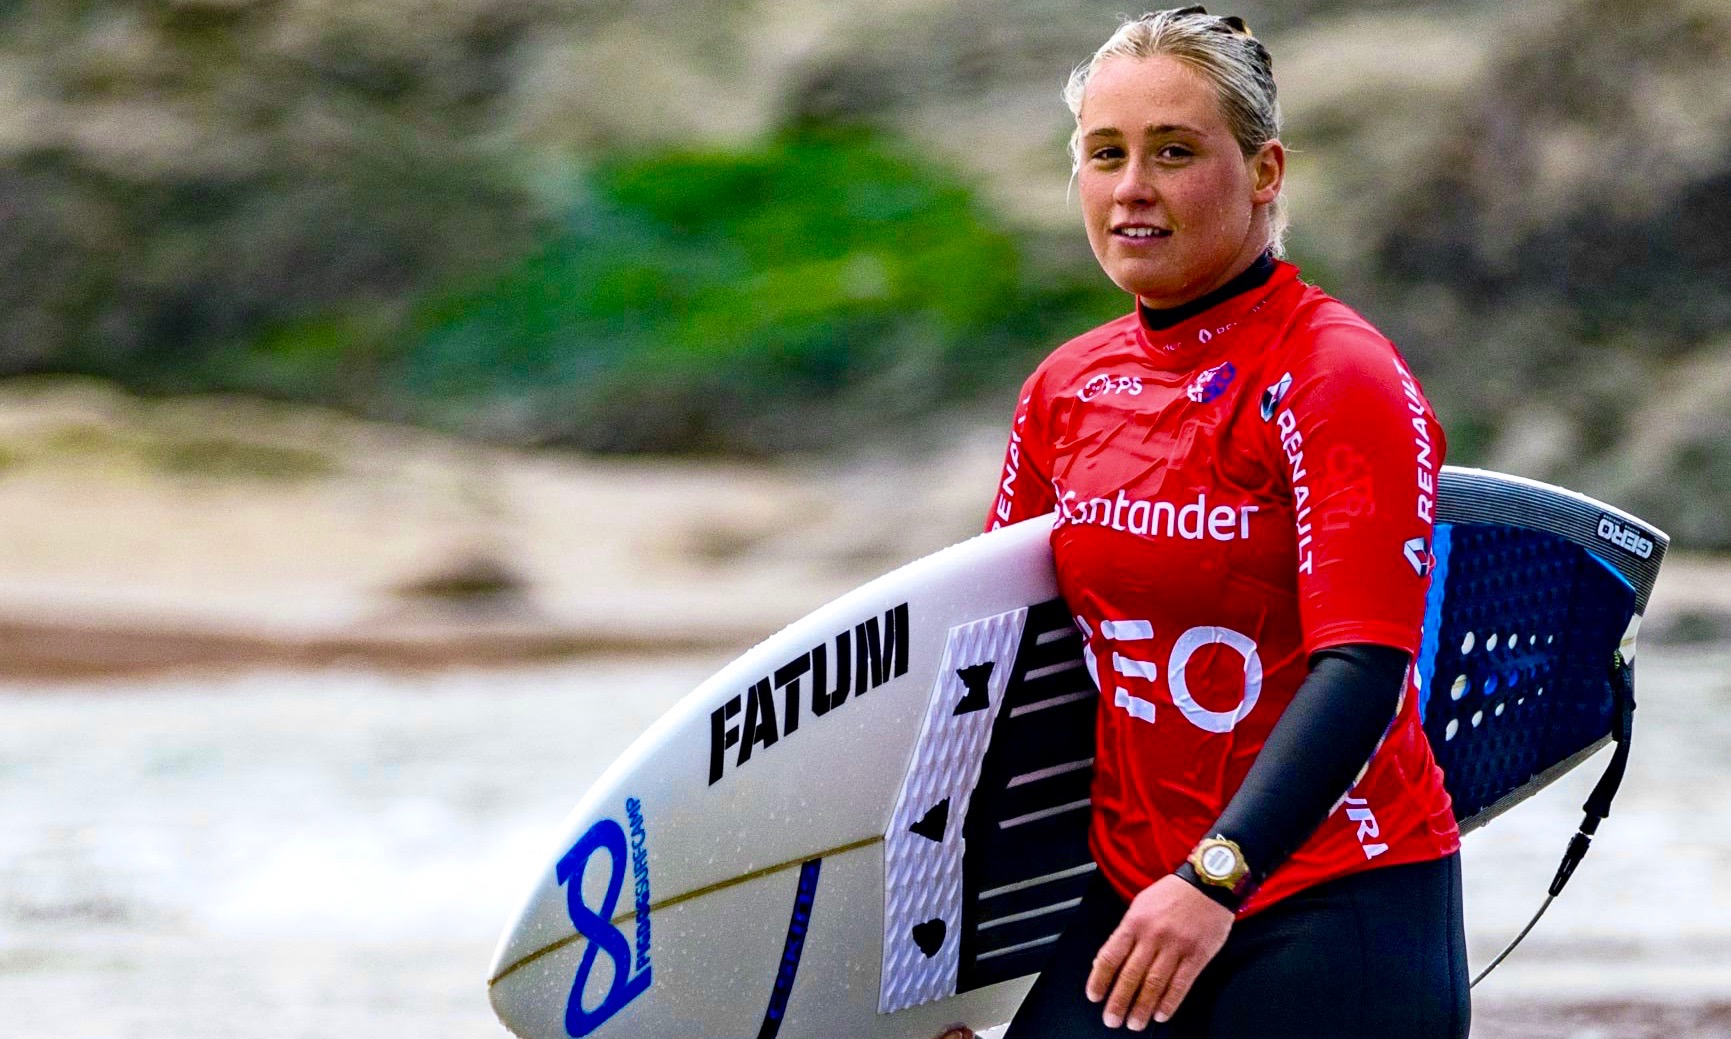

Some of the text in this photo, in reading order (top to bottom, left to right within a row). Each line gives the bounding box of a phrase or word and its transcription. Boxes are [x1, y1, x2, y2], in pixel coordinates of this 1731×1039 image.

[1277, 408, 1312, 575] RENAULT
[1392, 357, 1433, 524] RENAULT
[1597, 518, 1653, 560] GERO
[708, 602, 909, 786] FATUM
